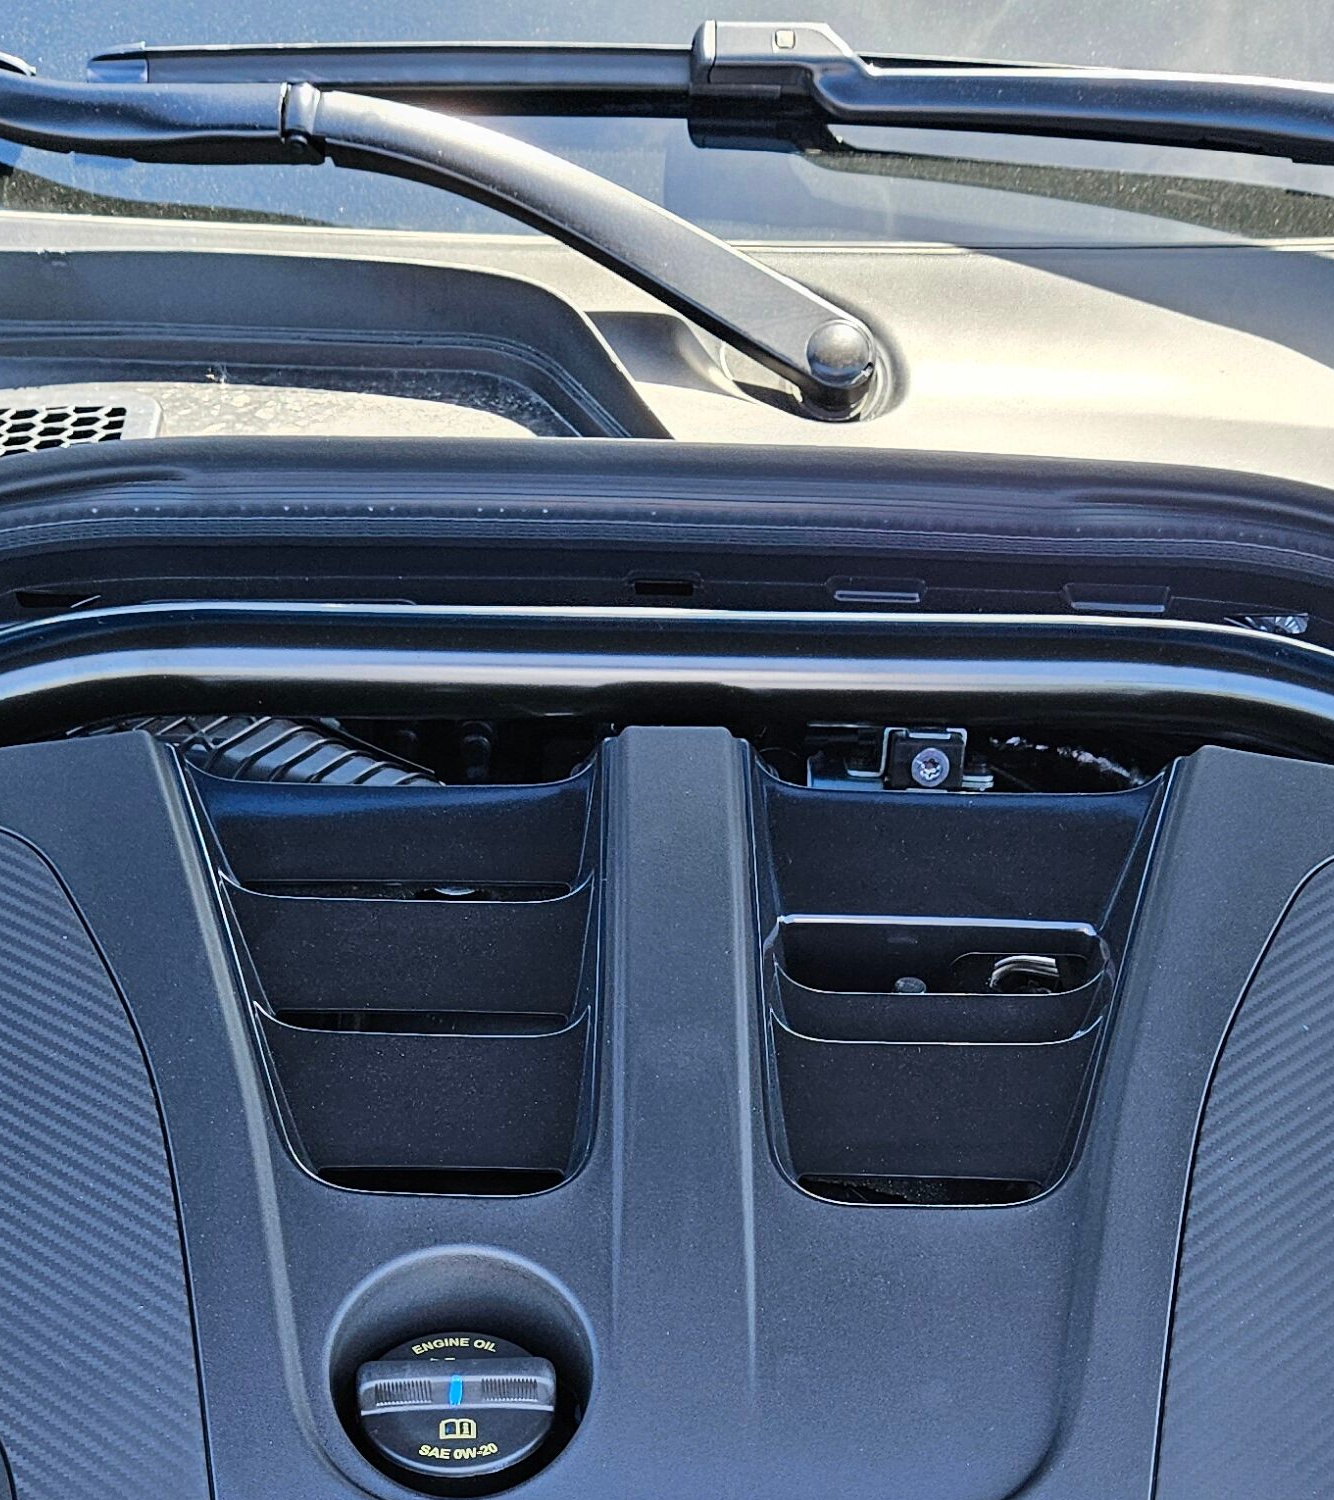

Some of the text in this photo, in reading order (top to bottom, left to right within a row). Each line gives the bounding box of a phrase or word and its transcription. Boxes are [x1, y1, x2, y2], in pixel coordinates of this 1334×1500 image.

[412, 1337, 497, 1355] ENGINE OIL
[418, 1442, 499, 1460] SAE 0W-20
